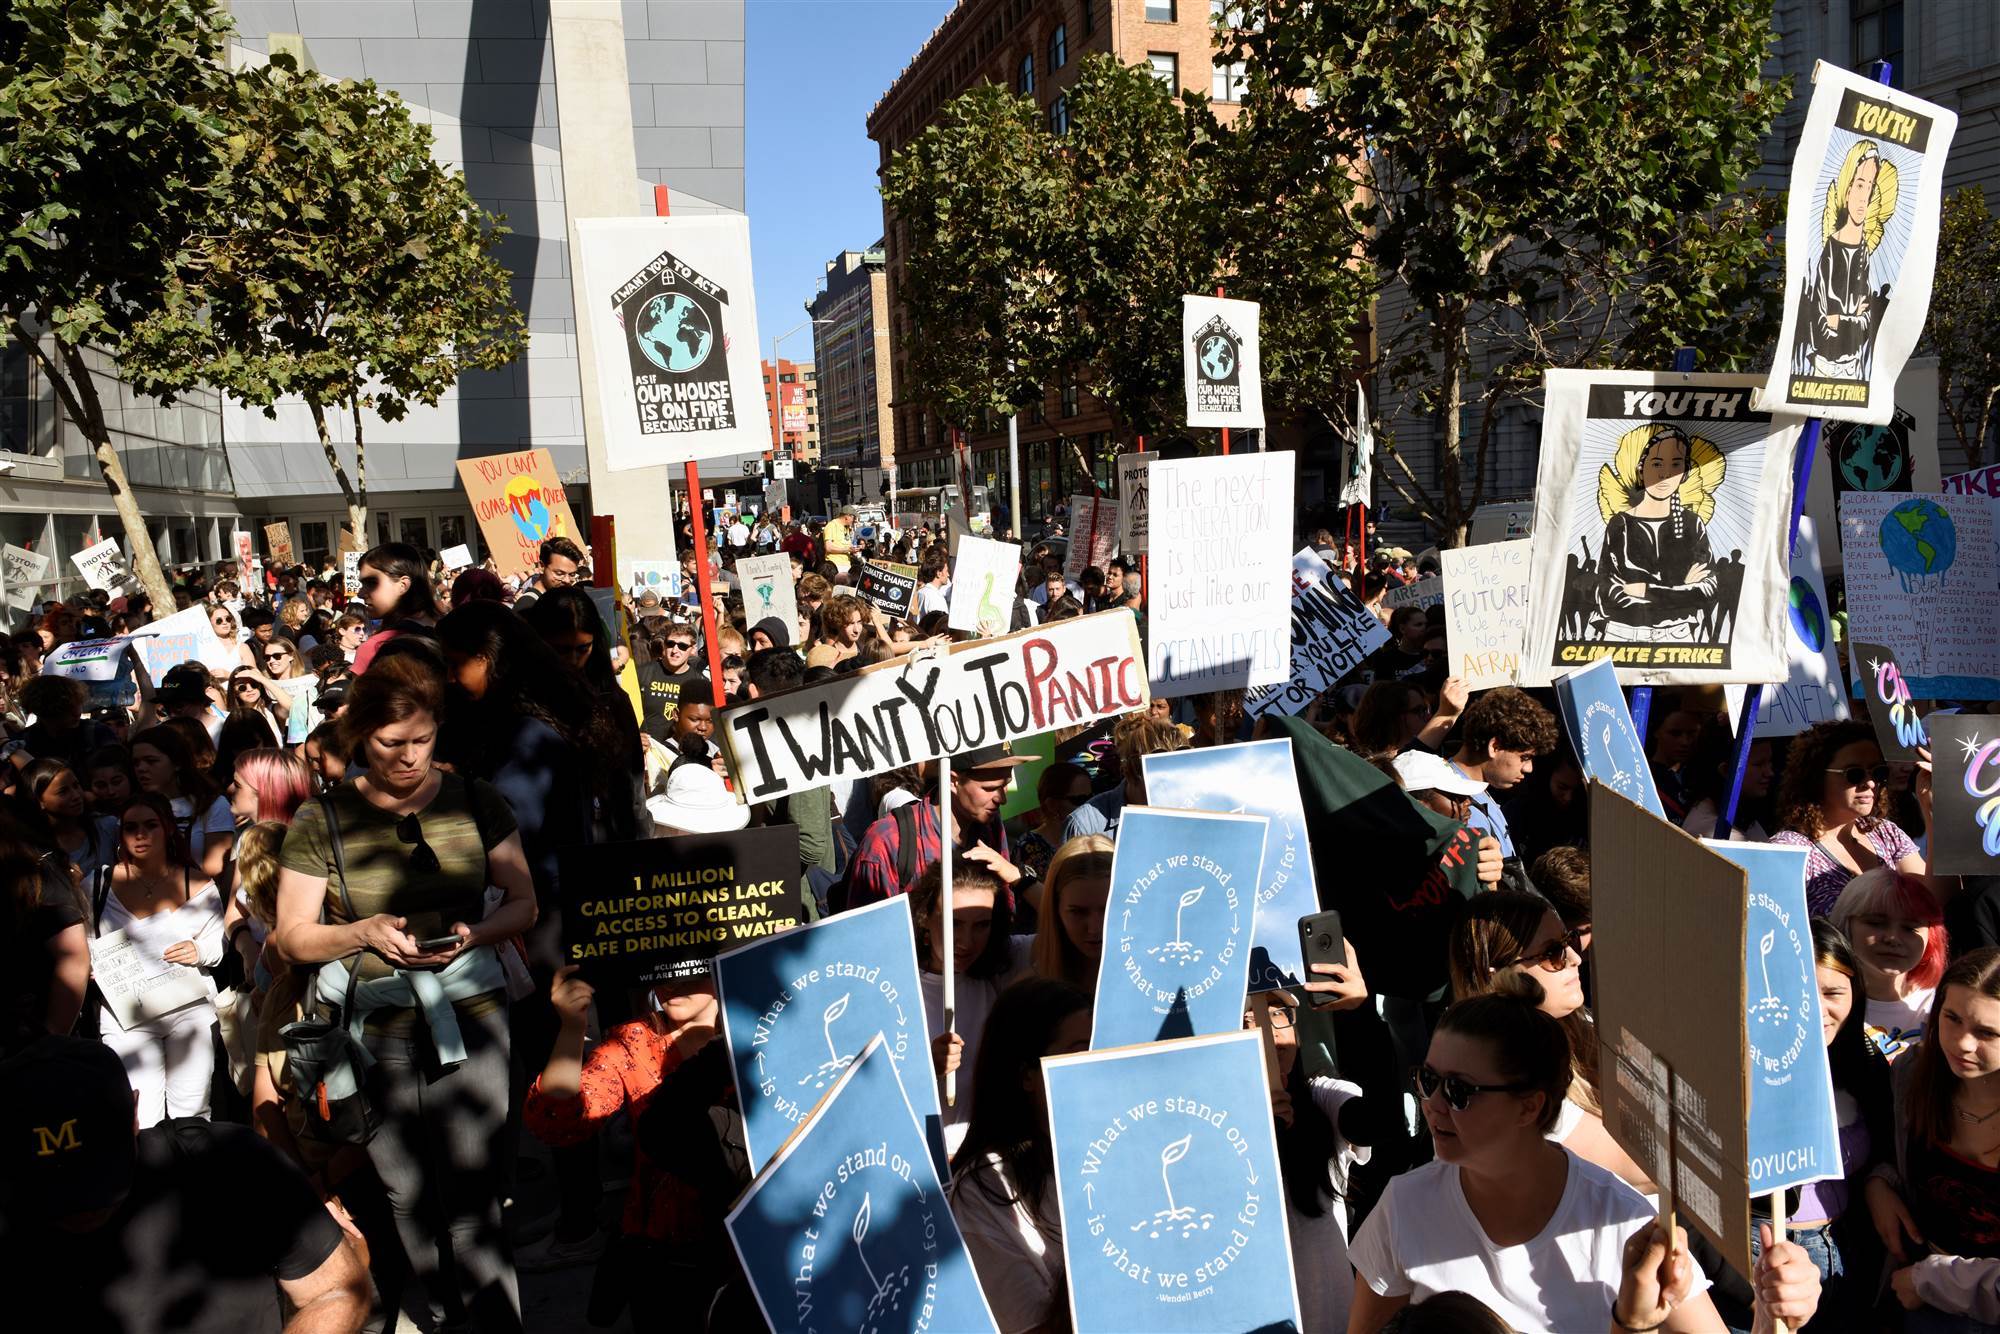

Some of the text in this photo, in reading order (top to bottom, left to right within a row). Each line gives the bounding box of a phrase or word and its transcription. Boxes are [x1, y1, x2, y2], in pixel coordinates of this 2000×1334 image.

[1854, 100, 1918, 145] YOUTH
[619, 274, 648, 298] WANT
[647, 254, 668, 276] YOU
[673, 260, 690, 279] TO
[694, 276, 721, 296] ACT
[635, 375, 657, 386] AS IF
[637, 381, 730, 404] OUR HOUSE
[1198, 385, 1239, 395] OUR HOUSE
[1791, 380, 1866, 402] CLIMATE STRIKE
[641, 400, 733, 422] IS ON FIRE.
[1200, 396, 1208, 405] IS
[1208, 395, 1219, 404] ON
[1623, 390, 1744, 418] YOUTH
[643, 421, 695, 434] BECAUSE
[698, 417, 711, 430] IT
[475, 458, 502, 485] YOU
[1124, 467, 1149, 480] PROTE
[1159, 460, 1271, 508] The next
[475, 487, 567, 522] COMB OVER
[1843, 495, 1881, 504] GLOBAL
[1165, 503, 1271, 541] GENERATION
[82, 548, 115, 568] PROTECT
[1168, 549, 1184, 576] is
[1445, 545, 1522, 578] We Are
[864, 566, 883, 580] CLIMATE
[883, 574, 912, 589] CHANGE
[1470, 572, 1501, 586] The
[872, 596, 907, 611] EMERGENCY
[1160, 578, 1196, 621] just
[1205, 574, 1234, 607] like
[1242, 581, 1272, 603] our
[1451, 584, 1528, 618] FUTURE
[1850, 605, 1882, 613] EFFECT
[1468, 612, 1523, 633] We Are
[1935, 626, 1998, 635] WATER AND
[1298, 613, 1376, 665] YOU LIKE
[1475, 632, 1509, 649] Not
[1935, 637, 1997, 646] AIR POLLUTION
[1156, 627, 1283, 683] OCEAN LEVELS
[1464, 650, 1519, 679] AFRAI
[1561, 645, 1724, 664] CLIMATE STRIKE
[1937, 660, 2000, 676] CHANGE
[651, 681, 680, 693] SUNR
[1285, 678, 1317, 703] OR
[1581, 700, 1627, 755] What we stand on
[732, 706, 789, 798] I
[776, 698, 913, 782] WANT
[1280, 844, 1297, 871] for
[634, 866, 734, 891] 1 MILLION
[1125, 854, 1240, 910] What we stand on
[580, 880, 785, 918] CALIFORNIANS LACK
[595, 902, 773, 937] ACCESS TO CLEAN,
[1758, 892, 1803, 956] stand on
[572, 941, 619, 959] SAFE
[625, 928, 727, 953] DRINKING
[1120, 935, 1135, 953] is
[1218, 938, 1237, 967] for
[656, 971, 673, 980] ARE
[674, 969, 691, 977] THE
[1123, 957, 1153, 997] what
[1180, 966, 1223, 1002] stand
[752, 960, 900, 1048] What we stand on
[1156, 989, 1176, 1004] we
[1764, 1054, 1780, 1072] we
[1781, 1023, 1807, 1070] stand
[1799, 991, 1810, 1025] for
[760, 1032, 909, 1124] is wha for
[32, 1118, 82, 1156] M
[1081, 1096, 1249, 1177] What we stand on
[795, 1141, 912, 1324] What we stand on
[923, 1211, 938, 1251] for
[1087, 1191, 1260, 1288] is what we stand for
[1193, 1285, 1215, 1300] Berry
